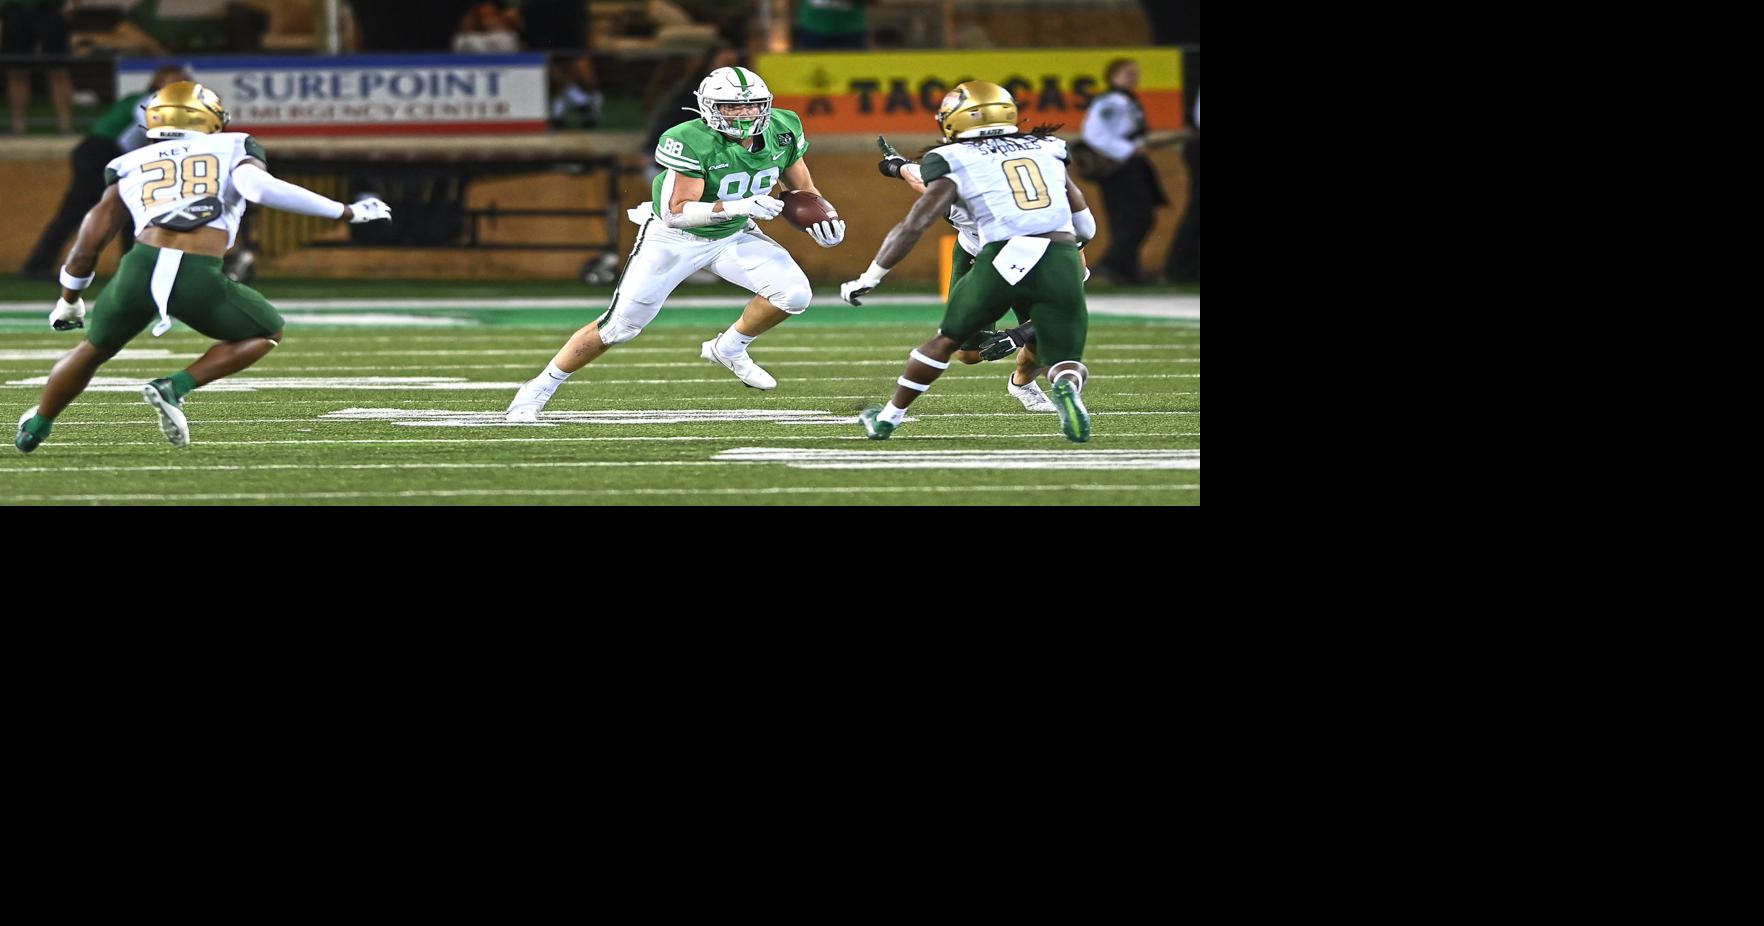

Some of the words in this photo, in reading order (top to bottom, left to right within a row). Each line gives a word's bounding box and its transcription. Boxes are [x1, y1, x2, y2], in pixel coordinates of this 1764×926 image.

[233, 71, 502, 101] SUREPOINT
[849, 76, 978, 116] TAC
[1002, 74, 1098, 114] CAS
[232, 103, 397, 120] EMERGENCY
[404, 101, 511, 118] CENTER
[159, 145, 190, 157] KEY
[663, 137, 684, 156] 88
[140, 153, 220, 210] 28
[1001, 157, 1052, 211] 0
